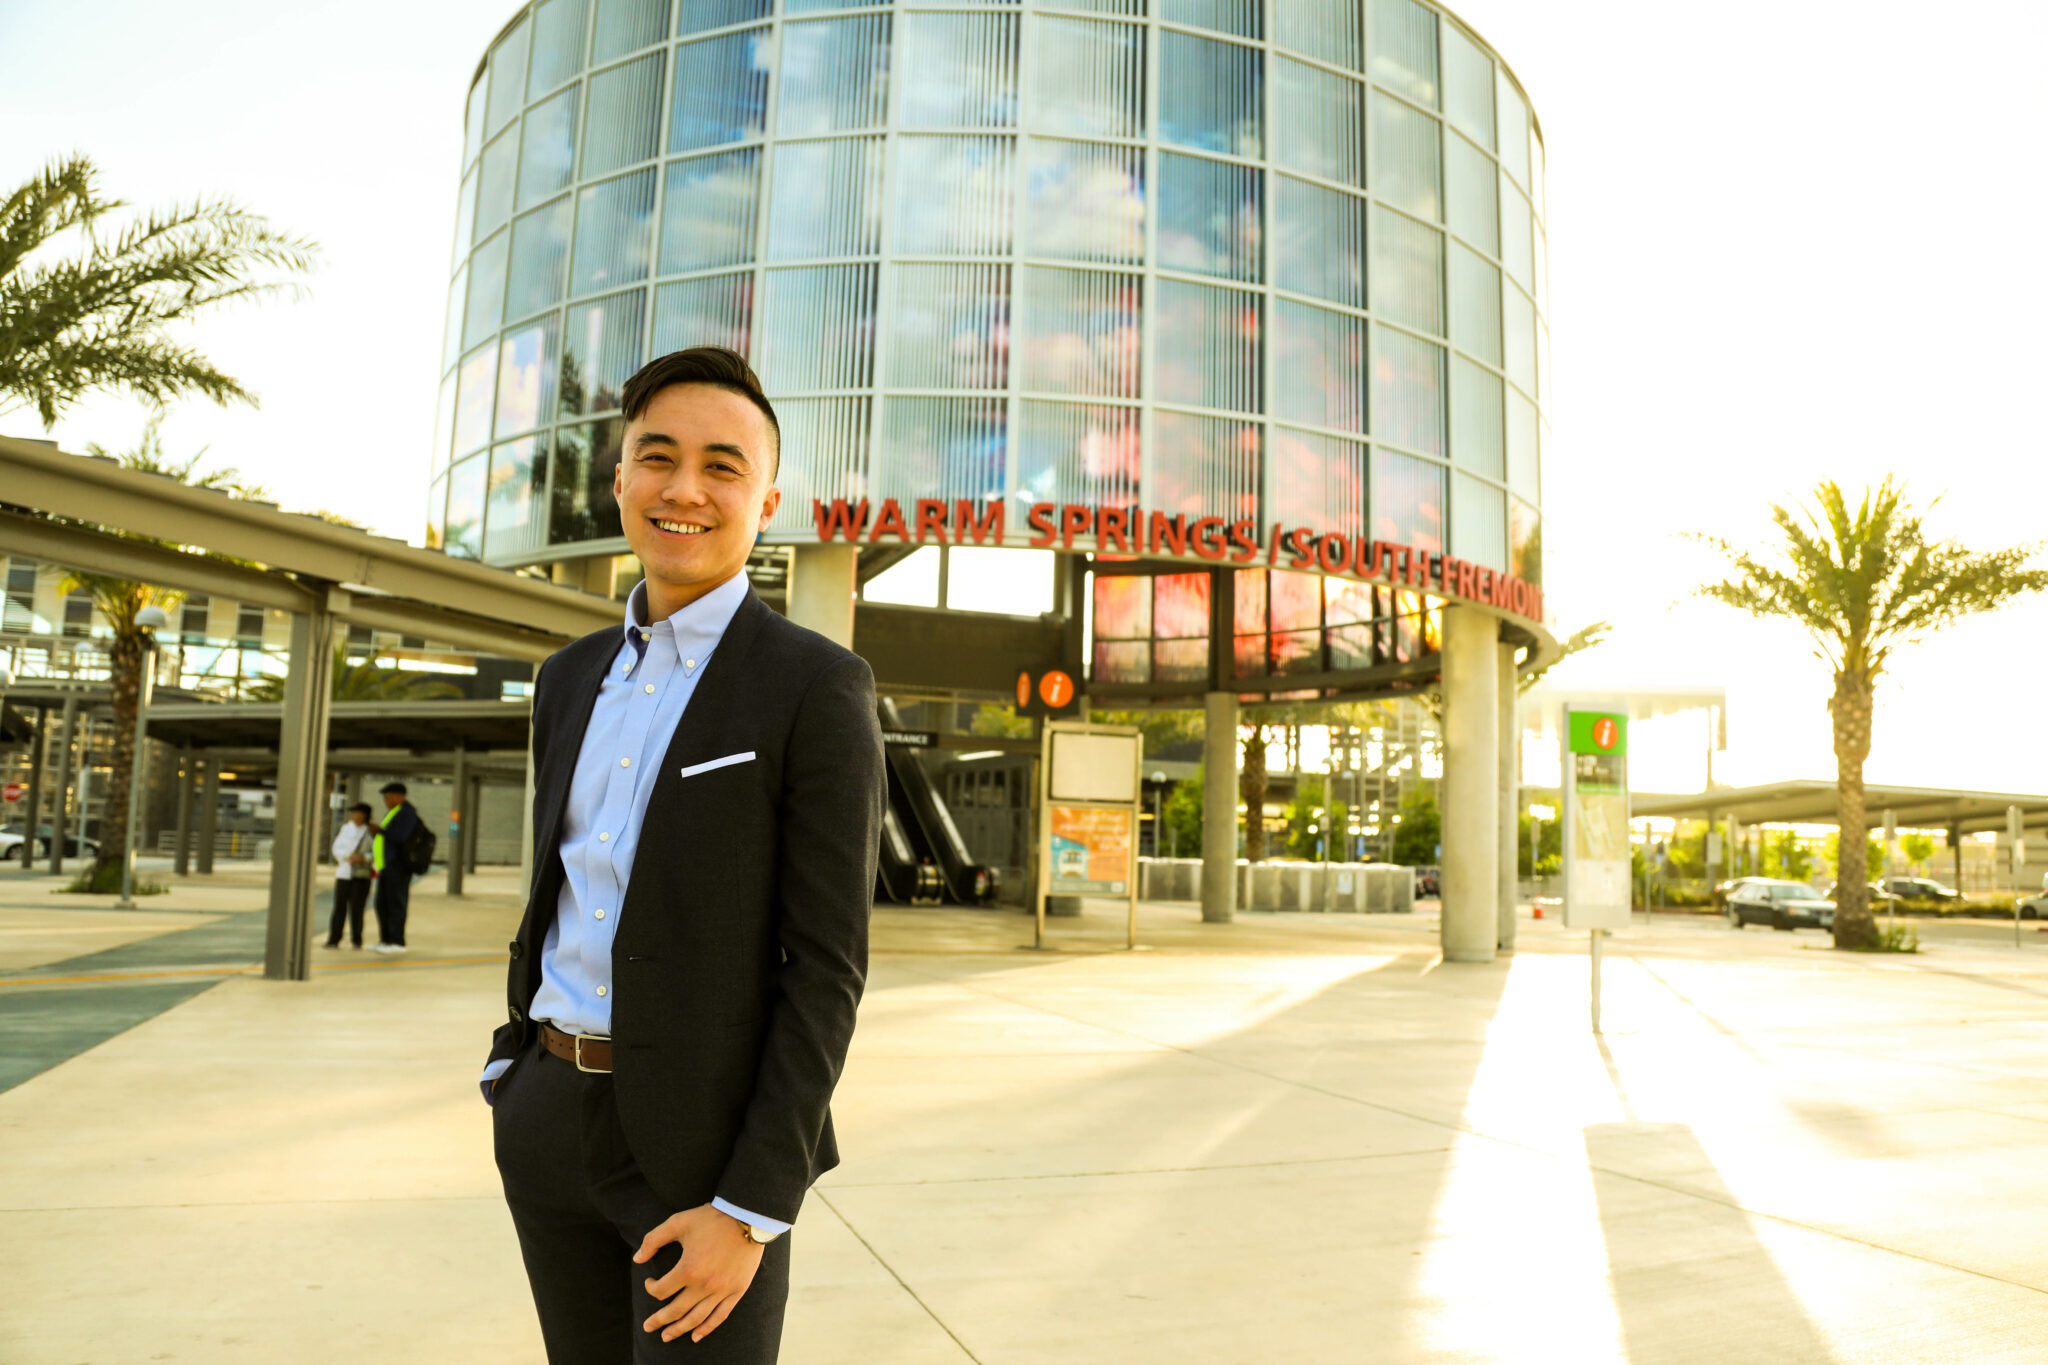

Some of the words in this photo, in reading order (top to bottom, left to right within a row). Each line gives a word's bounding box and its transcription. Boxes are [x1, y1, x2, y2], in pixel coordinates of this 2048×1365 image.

[813, 498, 1005, 545] WARM
[1029, 502, 1258, 563] SPRINGS
[1441, 554, 1545, 623] FREMONT
[882, 732, 928, 746] NTRANCE
